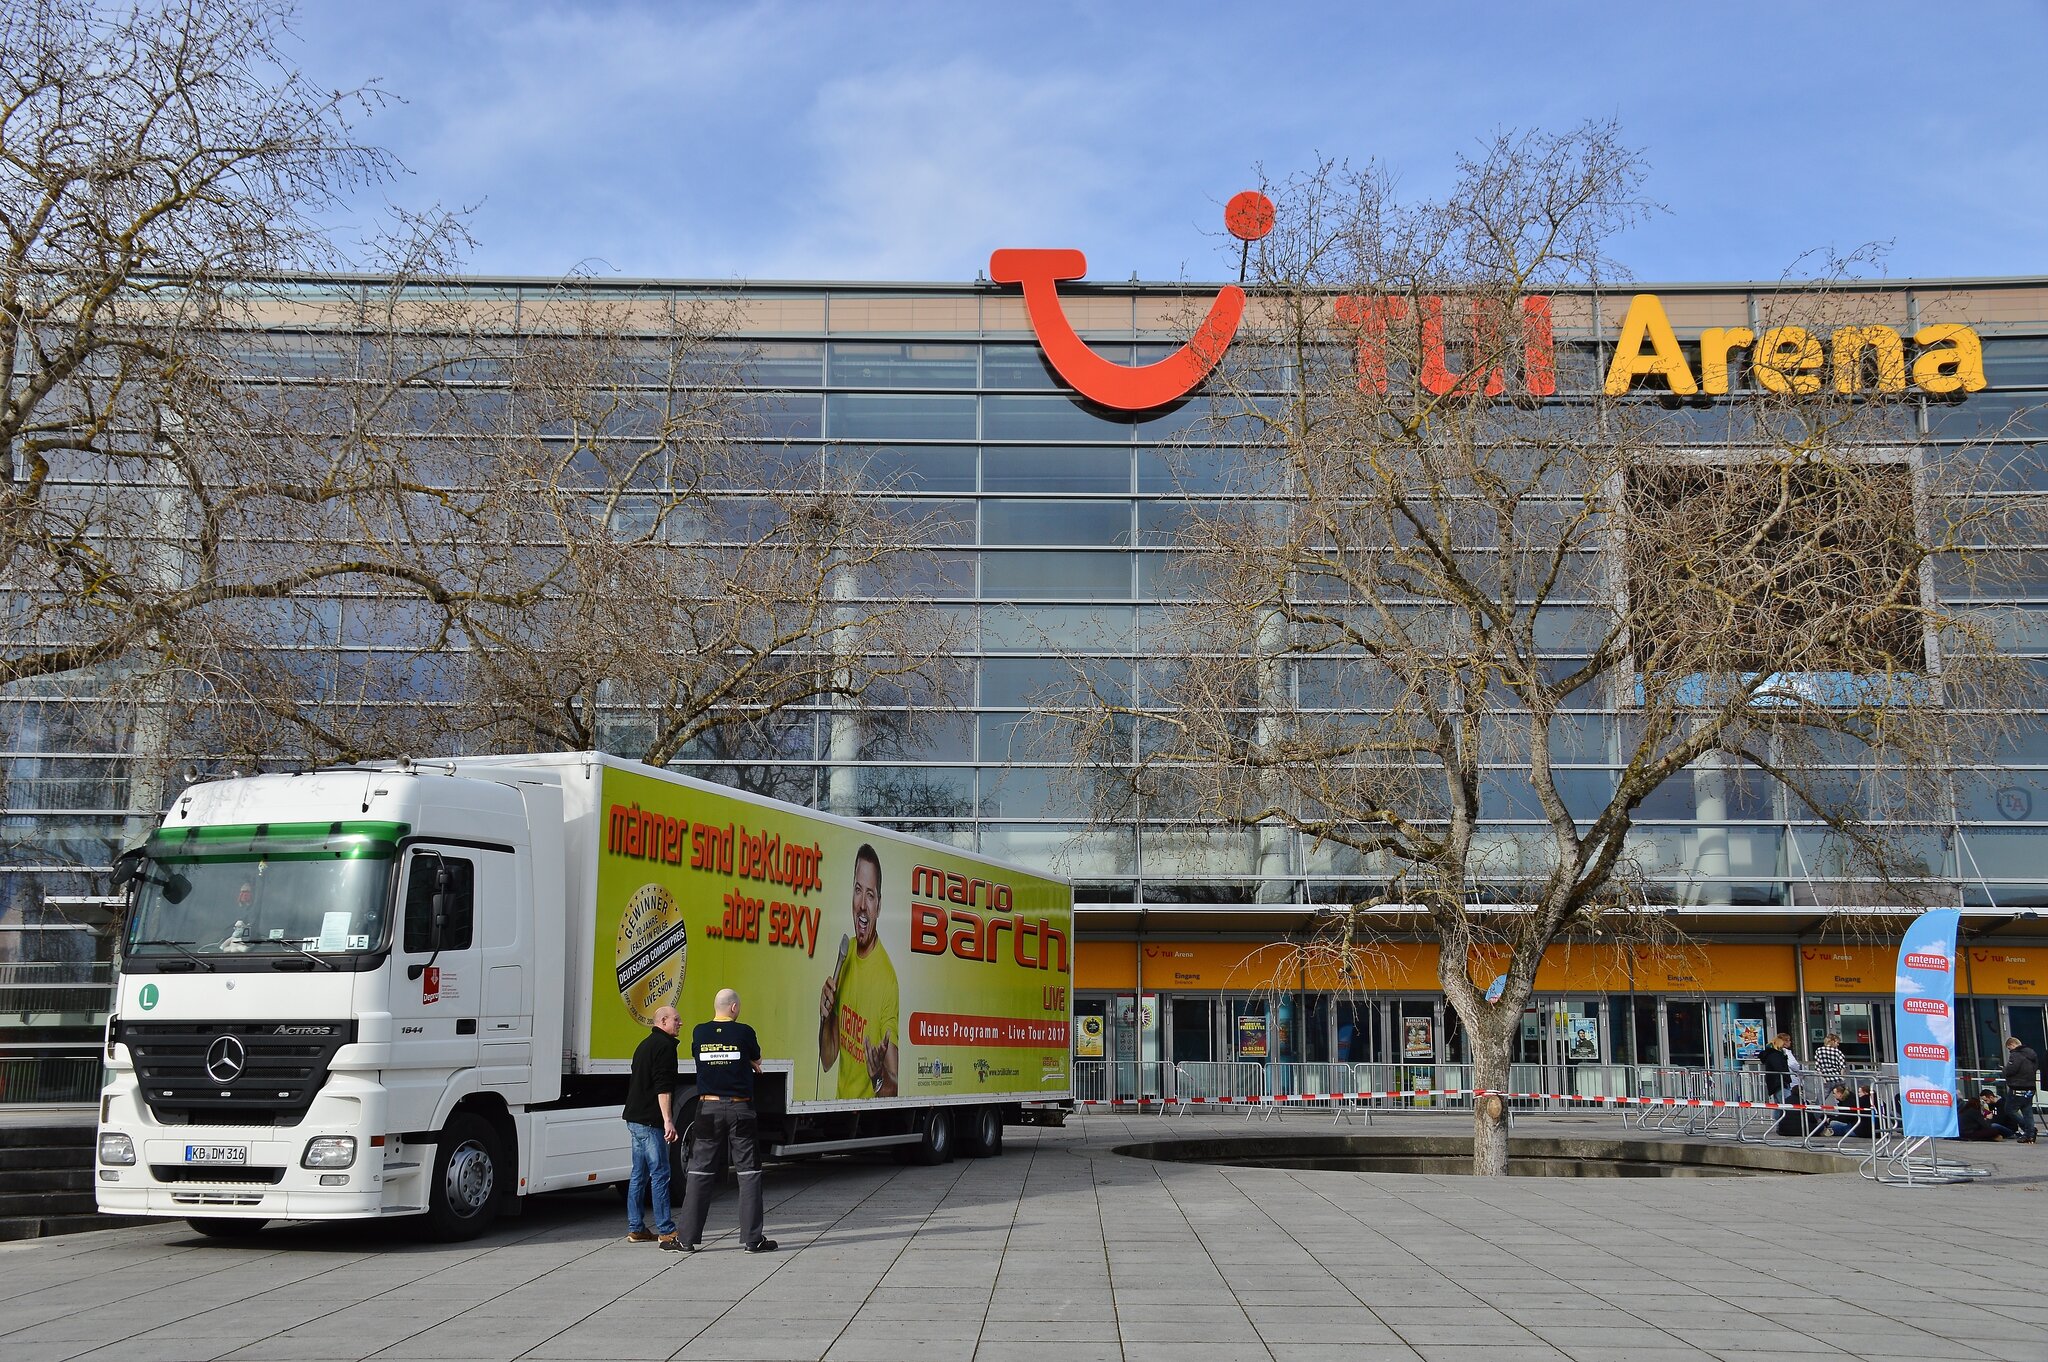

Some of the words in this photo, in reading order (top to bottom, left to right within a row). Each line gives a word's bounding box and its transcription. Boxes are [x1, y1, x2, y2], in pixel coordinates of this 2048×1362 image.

[1334, 295, 1556, 397] TUI
[1604, 294, 1988, 396] Arena
[608, 801, 688, 863] männer
[691, 823, 734, 873] sind
[624, 896, 669, 940] GEWINNER
[641, 914, 658, 934] JAHRE
[630, 934, 648, 954] (FAST)
[646, 931, 653, 943] IN
[653, 920, 669, 938] FOLGE
[768, 901, 821, 957] sexy
[618, 954, 650, 985] DEUTSCHER
[650, 928, 685, 961] COMEDYPREIS
[2005, 955, 2026, 963] Arena
[648, 971, 666, 991] BESTE
[1174, 972, 1200, 980] Eingang
[1834, 975, 1861, 983] Eingang
[2007, 978, 2036, 986] Eingang
[143, 988, 153, 1007] L
[643, 978, 674, 1008] LIVE-SHOW
[1043, 984, 1065, 1011] LIVE
[401, 1026, 423, 1034] 1844
[919, 1020, 949, 1038] Neues
[953, 1021, 999, 1042] Programm
[1008, 1024, 1025, 1040] Live
[1028, 1025, 1045, 1041] Tour
[1048, 1027, 1065, 1041] 2017
[192, 1147, 206, 1159] KB
[211, 1148, 225, 1159] DM
[226, 1148, 245, 1160] 316
